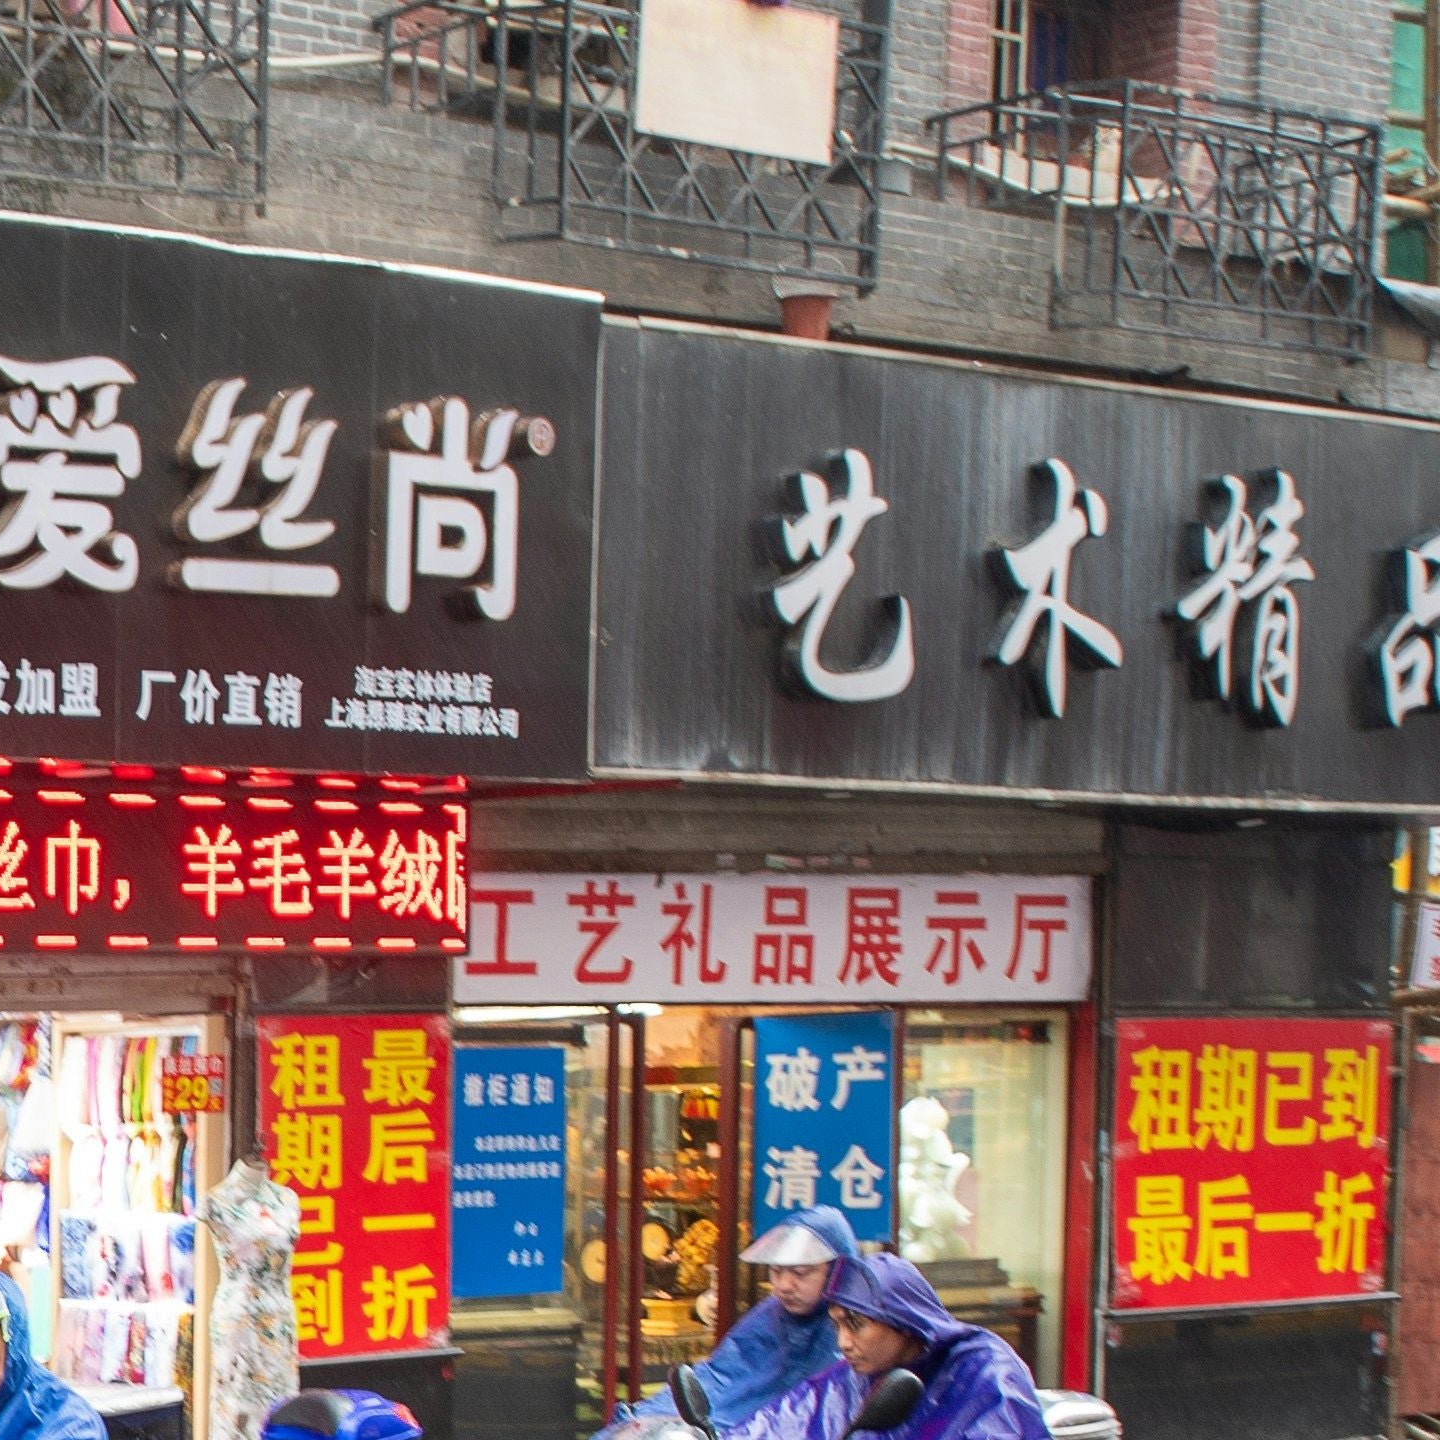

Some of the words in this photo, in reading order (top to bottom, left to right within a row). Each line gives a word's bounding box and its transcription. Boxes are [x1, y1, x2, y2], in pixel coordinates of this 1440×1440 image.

[135, 669, 305, 729] 厂价直销
[465, 879, 1071, 987] 工艺礼品展示厅
[173, 1074, 210, 1112] 29
[764, 1045, 888, 1112] 破产
[1129, 1042, 1381, 1155] 租期已到
[269, 1030, 346, 1348] 租期已到
[361, 1027, 439, 1343] 最后一折
[762, 1143, 886, 1211] 清仓
[1129, 1171, 1376, 1287] 最后一折
